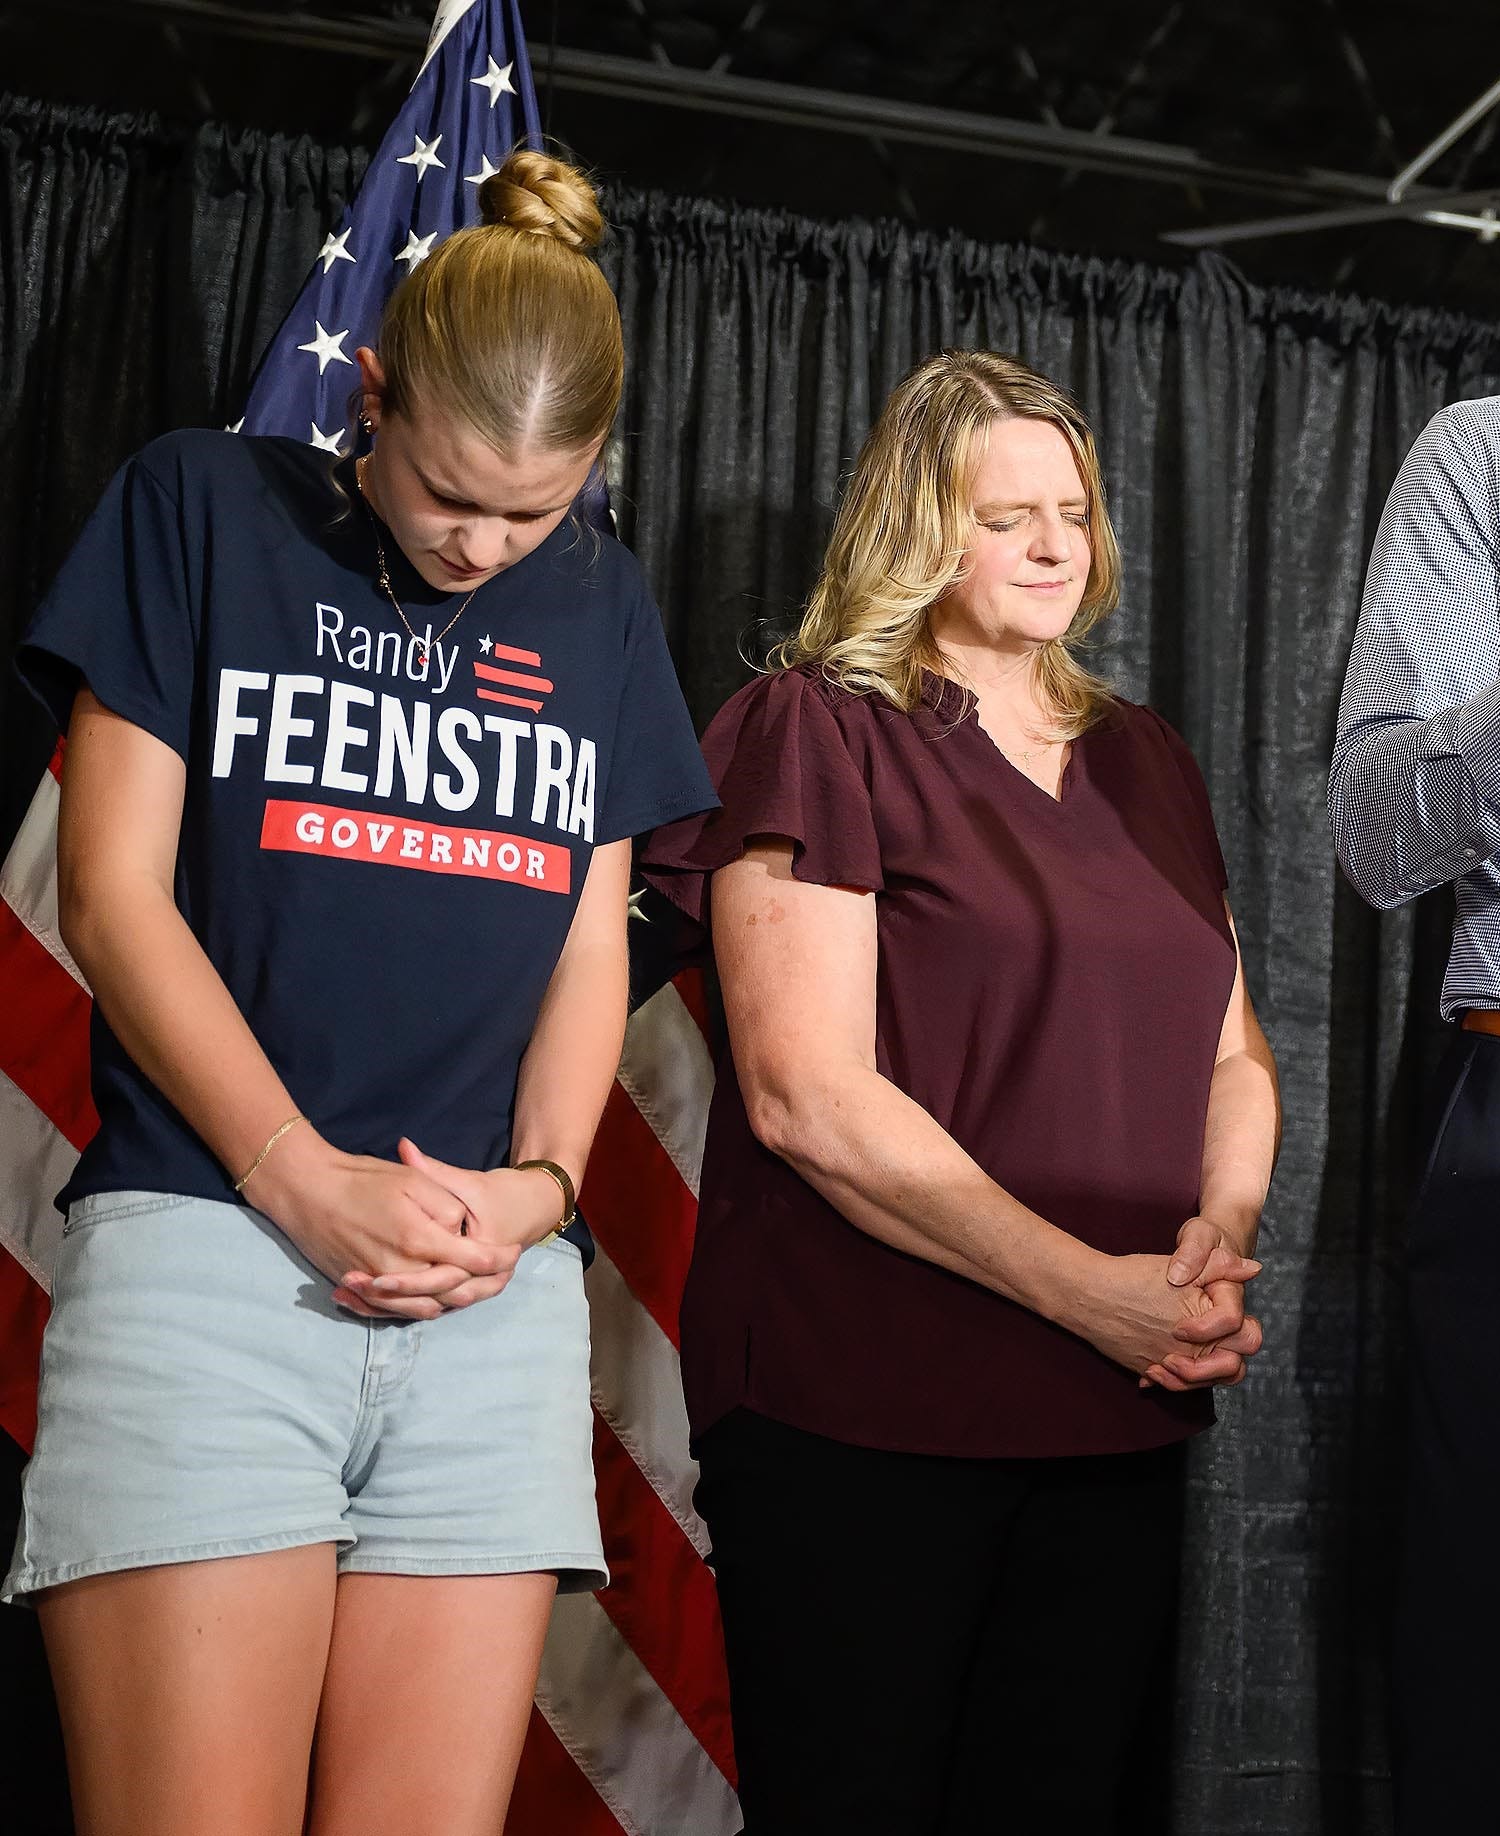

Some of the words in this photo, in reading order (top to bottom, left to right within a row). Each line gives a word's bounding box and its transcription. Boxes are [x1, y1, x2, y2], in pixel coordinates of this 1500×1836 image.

[315, 601, 460, 694] Randy
[212, 668, 596, 844] FEENSTRA
[296, 812, 546, 880] GOVERNOR
